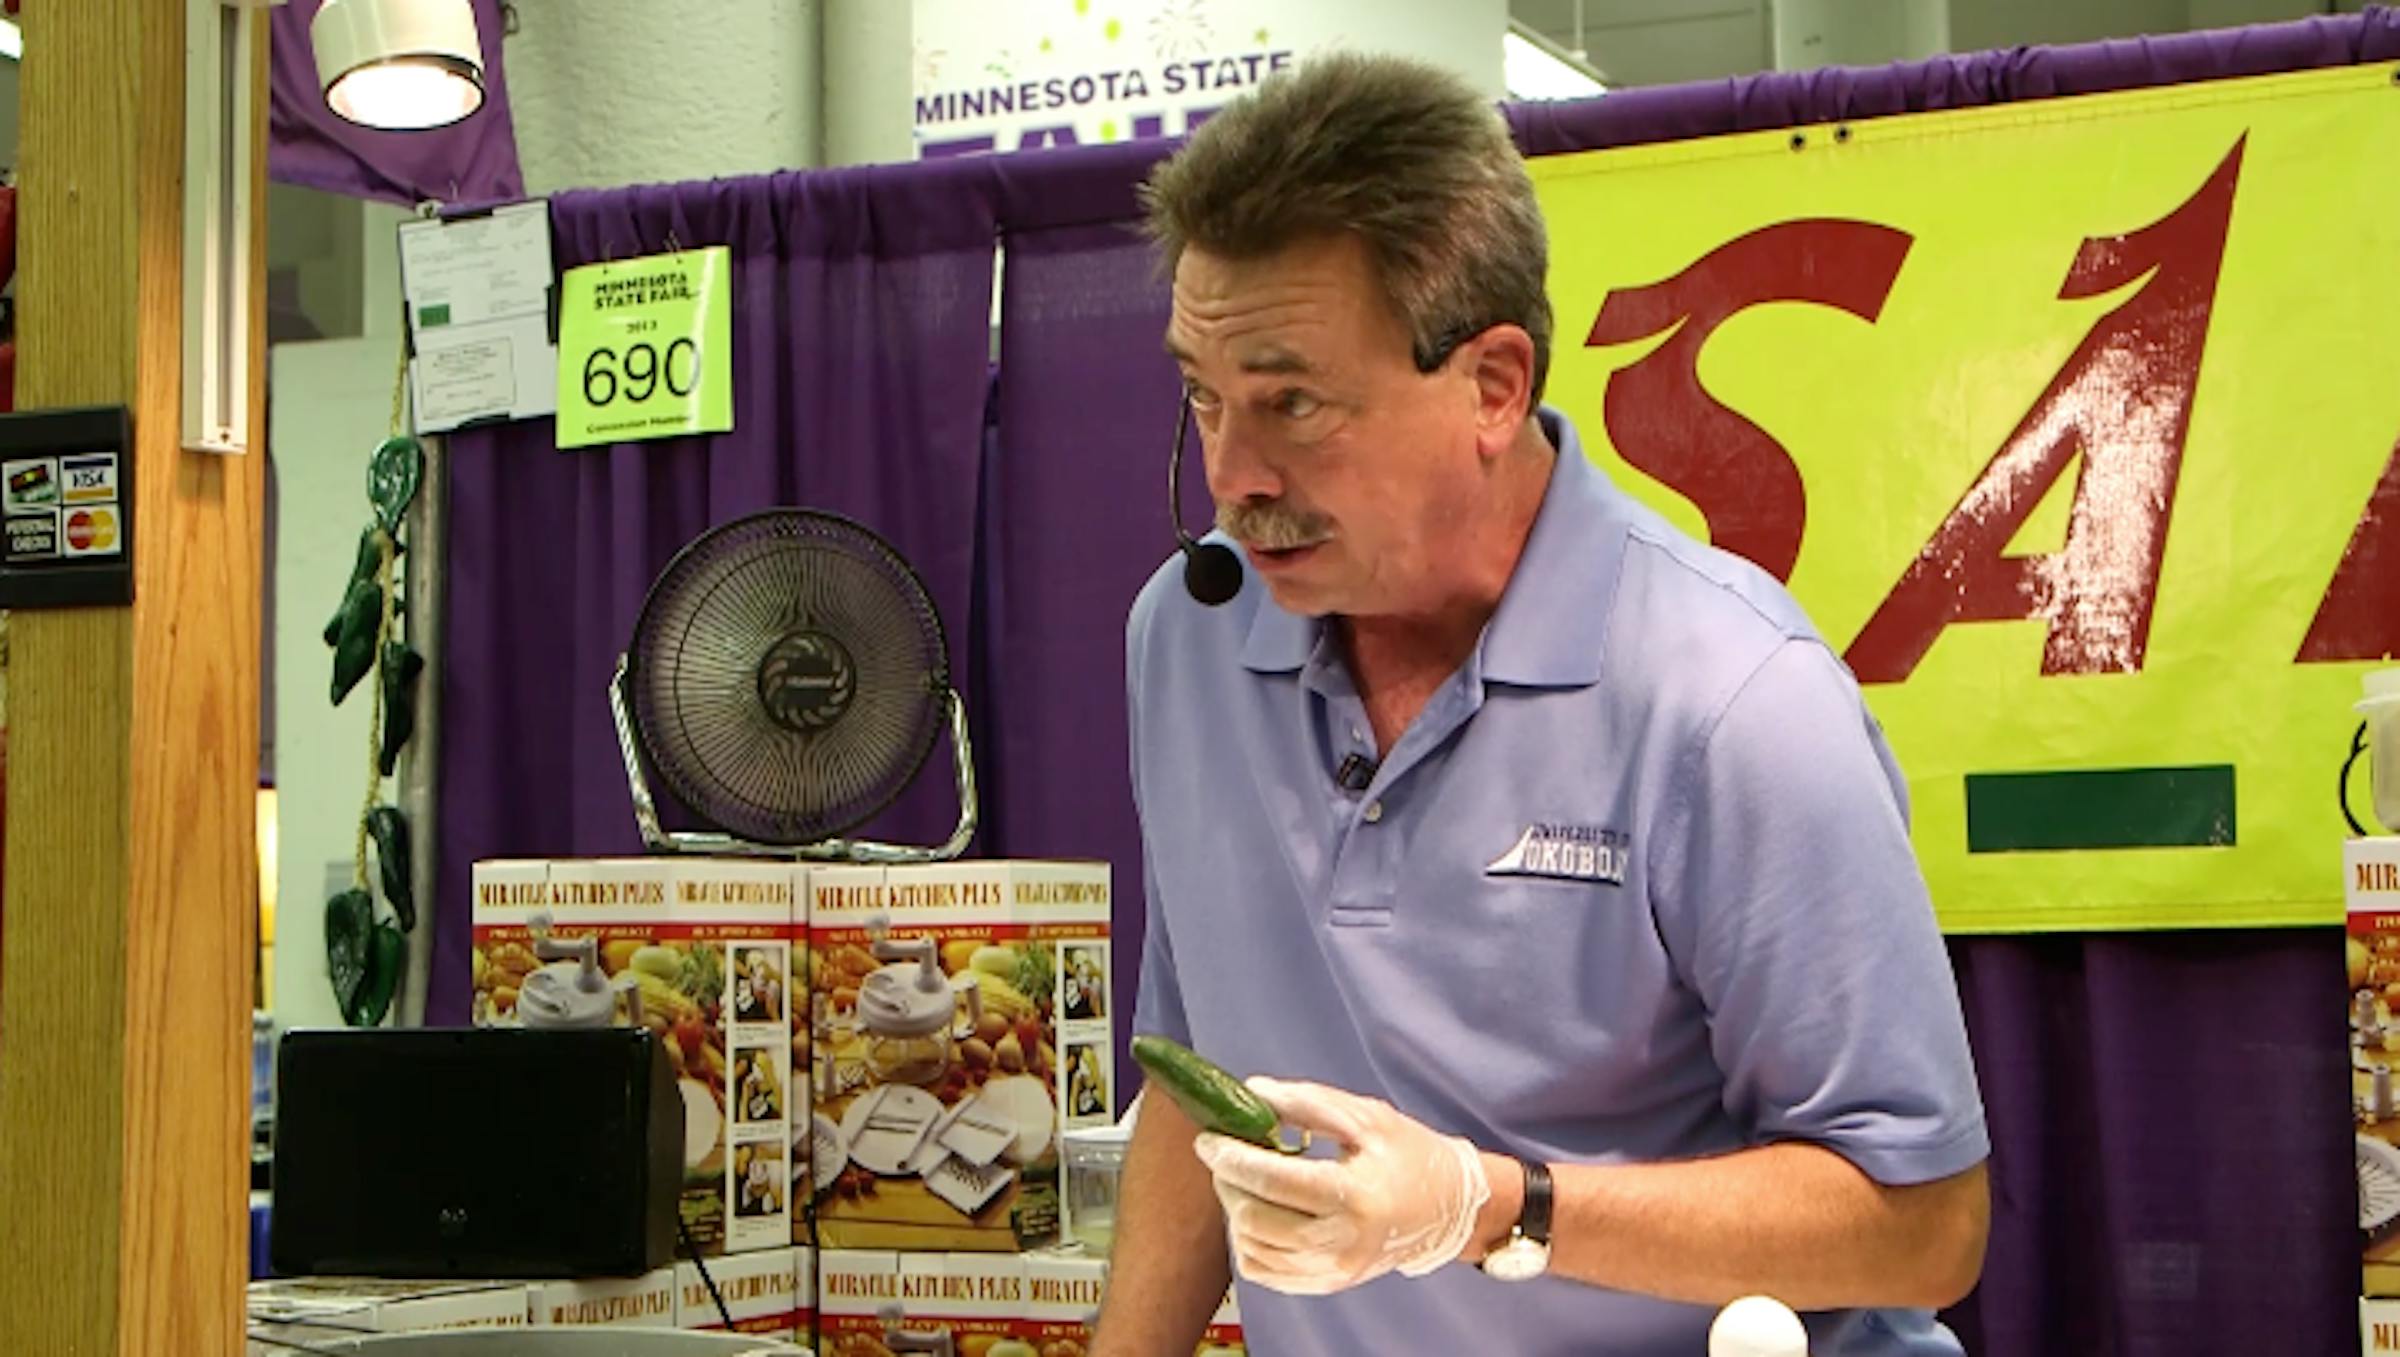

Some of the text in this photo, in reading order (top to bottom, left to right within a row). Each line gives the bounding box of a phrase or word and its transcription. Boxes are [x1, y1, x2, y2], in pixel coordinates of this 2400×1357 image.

[916, 51, 1293, 125] MINNESOTA STATE
[594, 272, 688, 295] MINNESOTA
[594, 285, 692, 310] STATE FAIR
[582, 337, 700, 407] 690
[1583, 127, 2400, 684] SA
[73, 468, 104, 488] VISA
[815, 884, 883, 911] MIRACLE
[962, 881, 1002, 906] PLUS
[826, 1272, 1021, 1301] MIRACLE KITCHEN PLUS
